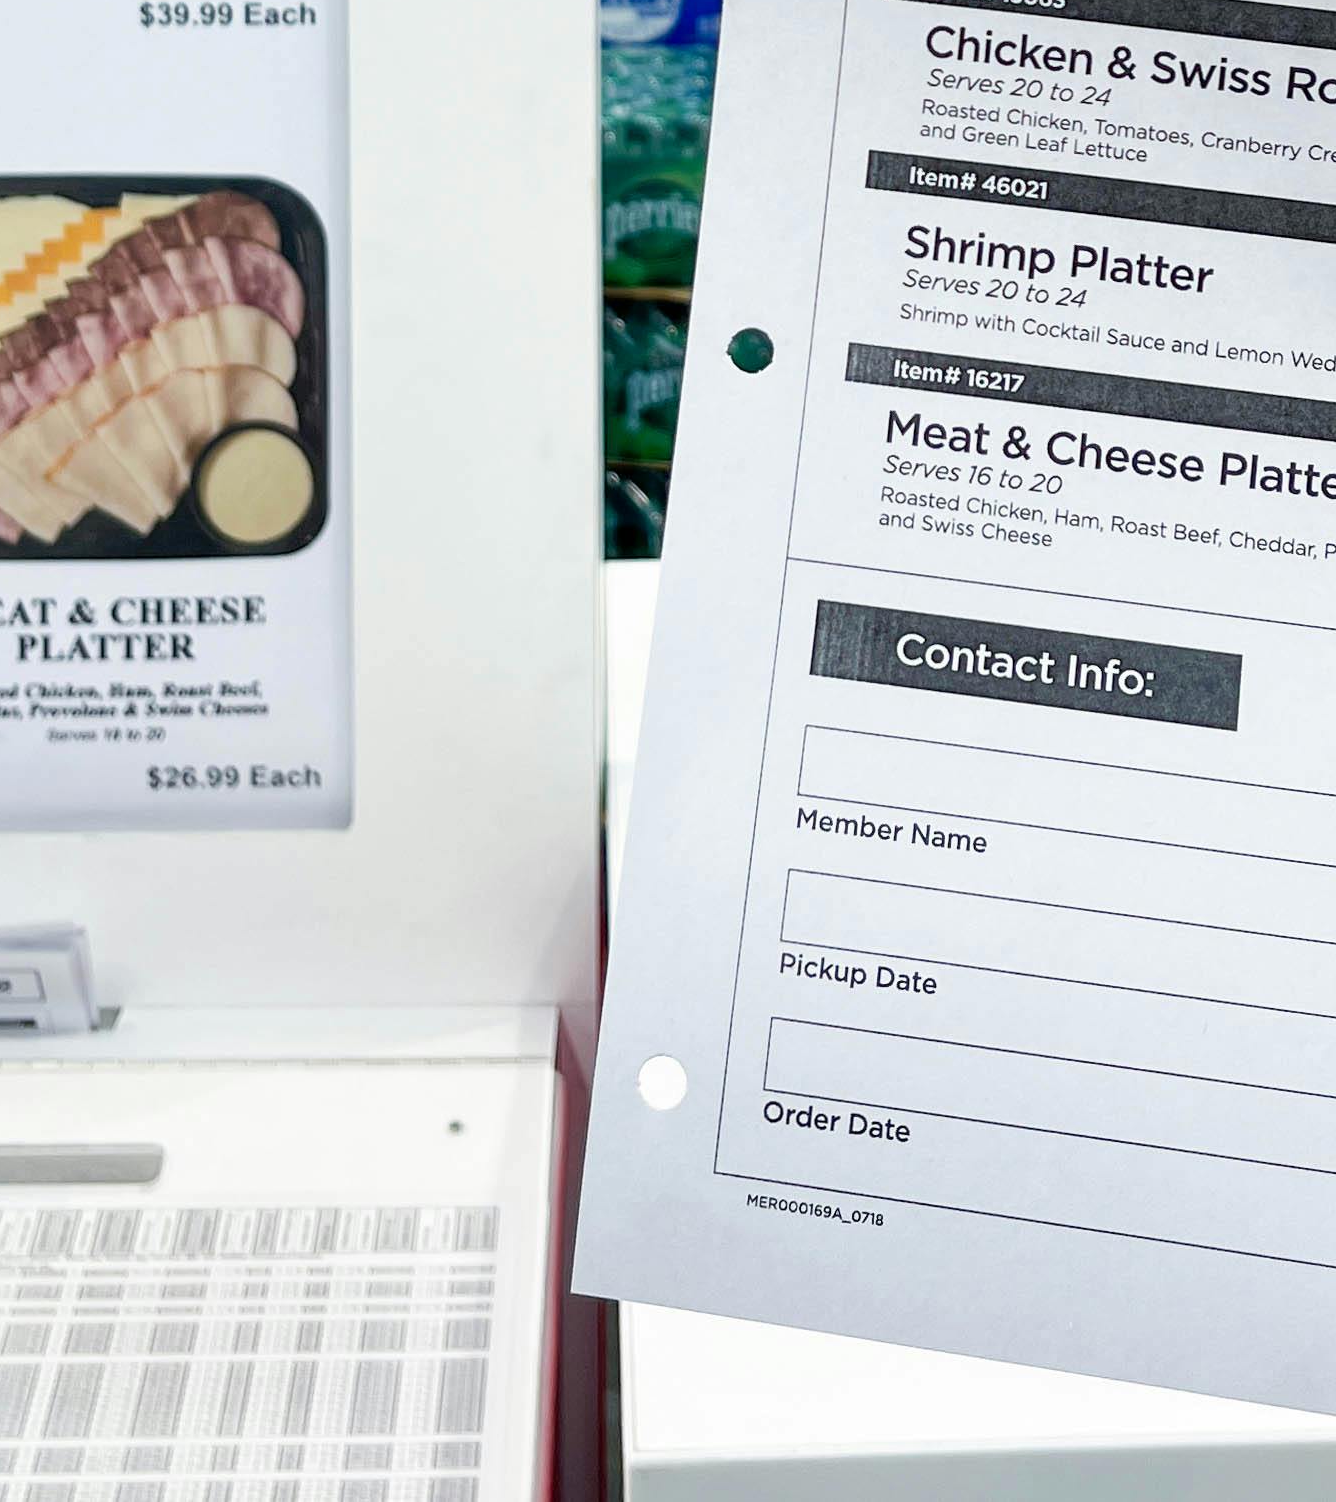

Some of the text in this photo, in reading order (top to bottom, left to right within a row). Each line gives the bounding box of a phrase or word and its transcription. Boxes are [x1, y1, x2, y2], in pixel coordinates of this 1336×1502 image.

[139, 2, 316, 27] $39.99 Each
[926, 25, 1093, 76] Chicken
[1107, 46, 1138, 80] &
[1150, 51, 1271, 96] Swiss
[927, 68, 1112, 107] Serves 20 to 24
[920, 121, 1148, 163] and Green Leaf Lettuce
[922, 99, 1000, 123] Roasted
[1006, 106, 1089, 135] Chicken,
[1094, 118, 1195, 148] Tomatoes,
[1200, 131, 1302, 161] Cranberry
[909, 166, 1048, 199] Item# 46021
[905, 225, 1214, 294] Shrimp Platter
[903, 269, 1088, 308] Serves 20 to 24
[900, 303, 970, 333] Shrimp
[974, 313, 1017, 334] with
[1022, 318, 1101, 345] Cocktail
[1106, 327, 1165, 352] Sauce
[1170, 335, 1209, 356] and
[1215, 340, 1285, 366] Lemon
[893, 359, 1026, 392] Item# 16217
[886, 410, 990, 456] Meat
[1002, 425, 1033, 460] &
[1046, 430, 1205, 482] Cheese
[882, 454, 1063, 494] Serves 16 to 20
[879, 508, 1053, 547] and Swiss Cheese
[880, 486, 960, 513] Roasted
[966, 495, 1048, 525] Chicken,
[1054, 506, 1104, 533] Ham,
[1110, 514, 1168, 539] Roast
[1173, 522, 1223, 548] Beef,
[1229, 530, 1318, 560] Cheddar,
[68, 598, 95, 626] &
[110, 596, 267, 625] CHEESE
[16, 632, 195, 662] PLATTER
[895, 632, 1156, 698] Contact Info:
[147, 764, 322, 790] $26.99 Each
[796, 807, 988, 854] Member Name
[779, 952, 938, 996] Pickup Date
[763, 1101, 911, 1144] Order Date
[746, 1194, 885, 1227] MER000169A_0718
